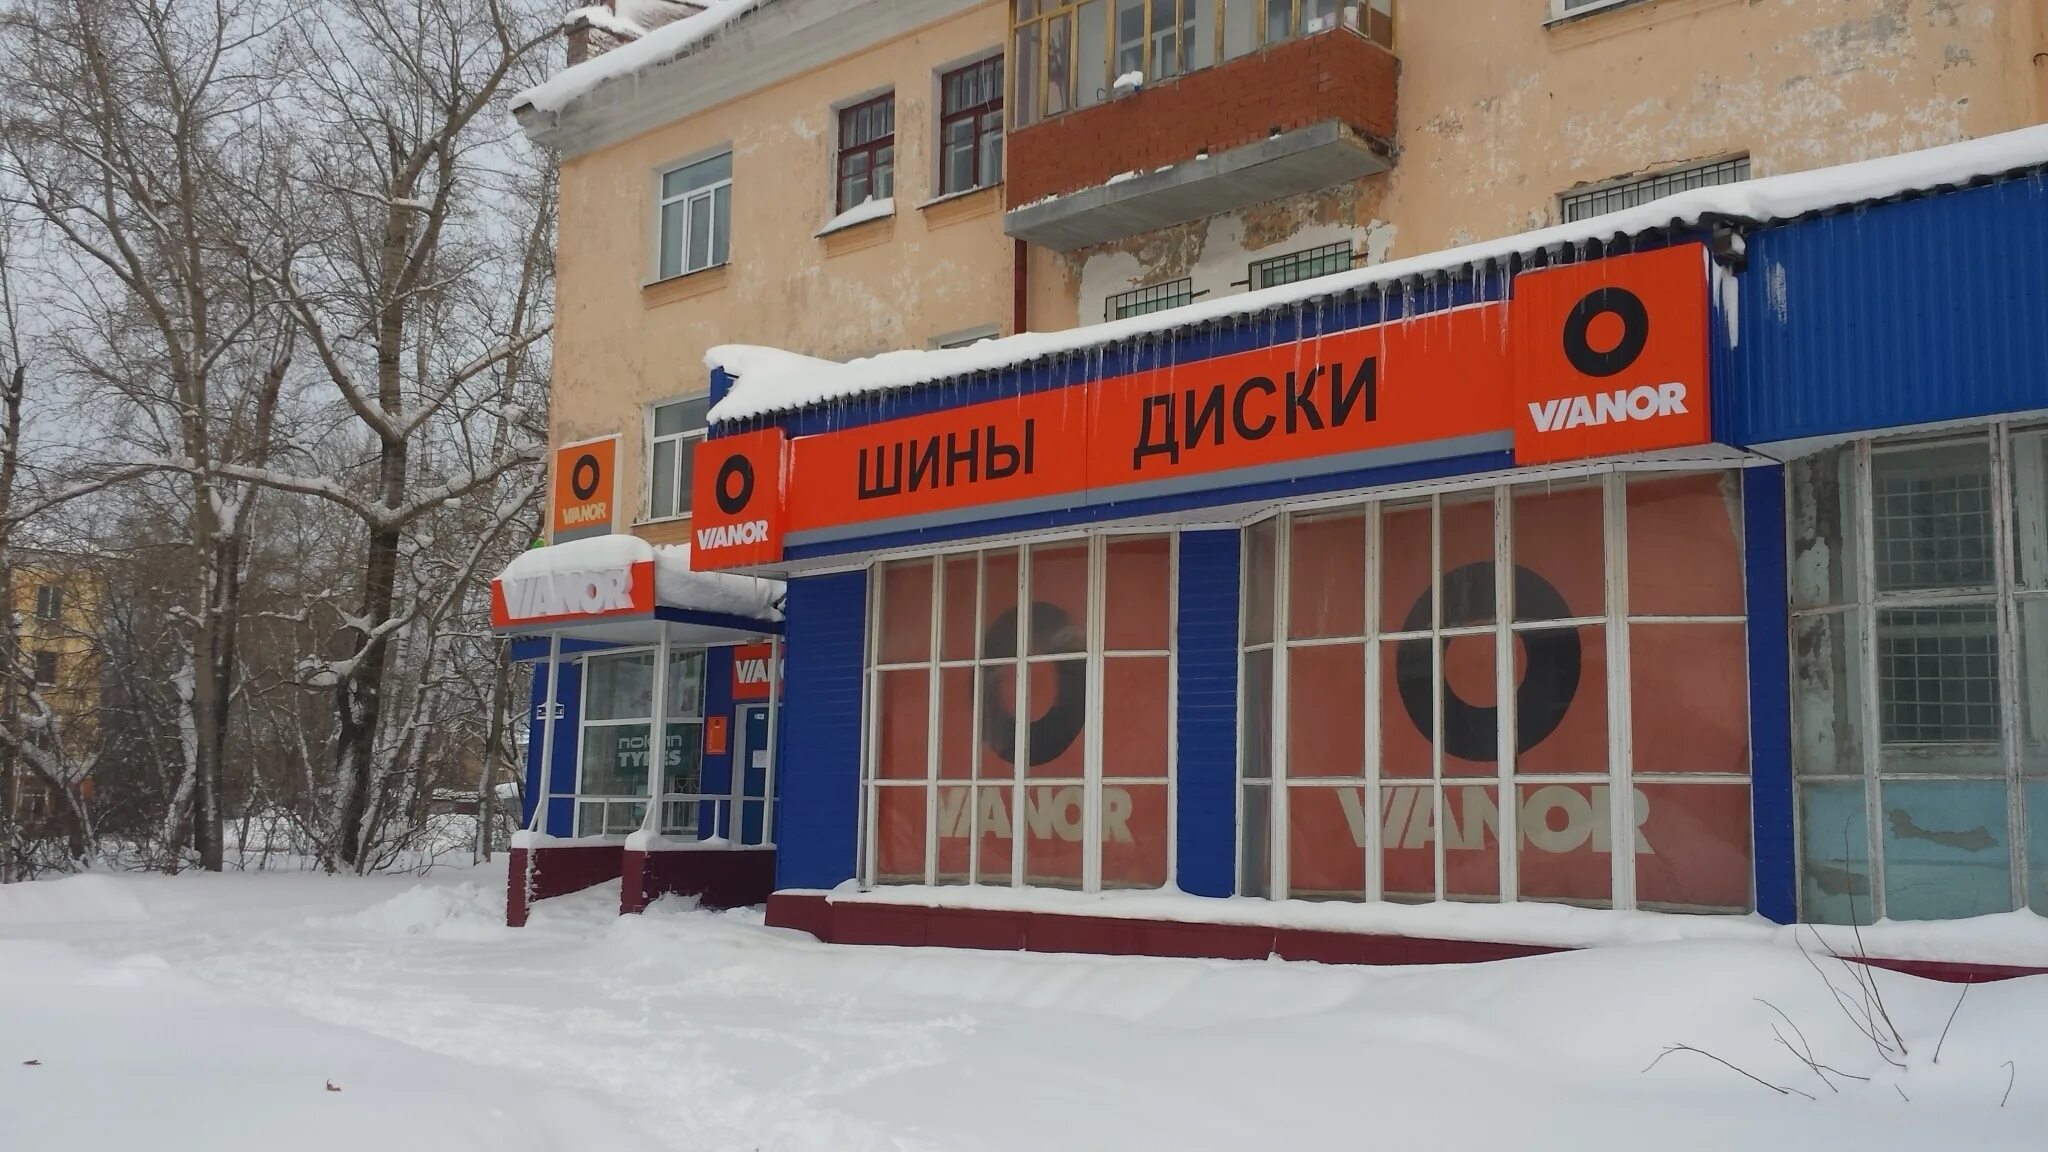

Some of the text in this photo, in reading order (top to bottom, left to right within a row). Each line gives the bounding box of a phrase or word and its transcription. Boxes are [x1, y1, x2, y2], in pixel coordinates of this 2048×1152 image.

[1528, 382, 1688, 432] VIANOR
[858, 356, 1376, 500] ШИНЫ ДИСКИ
[563, 502, 607, 525] VIANOR
[697, 520, 768, 551] VIANOR
